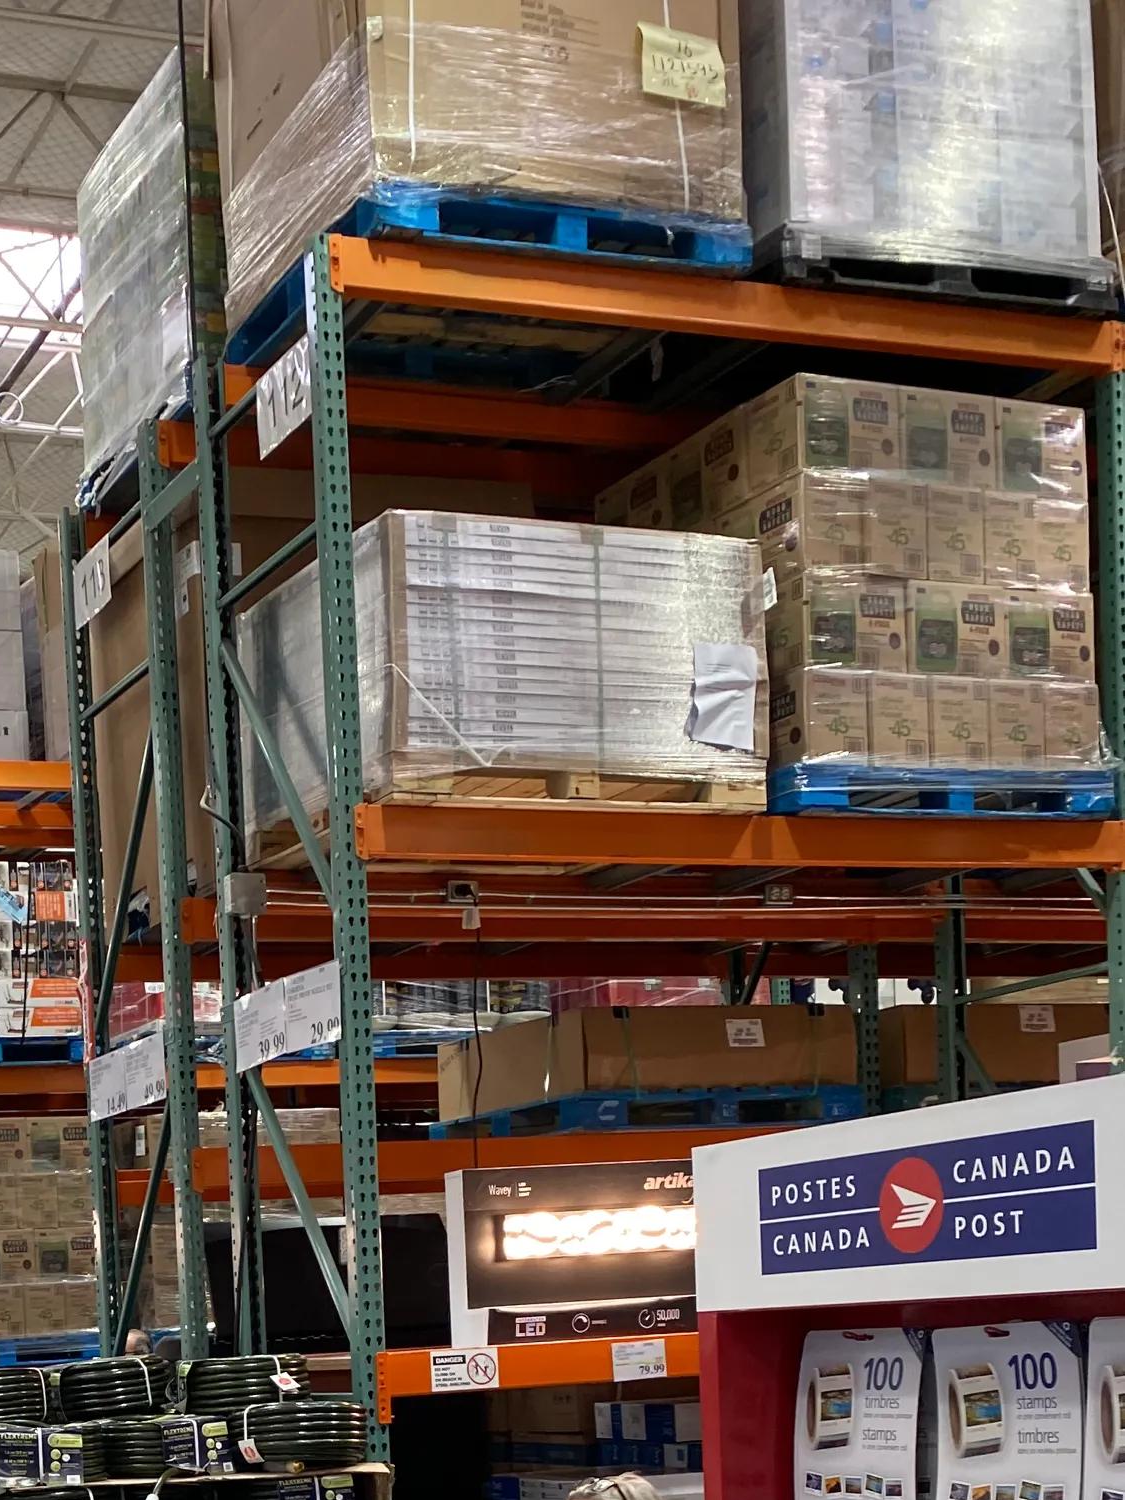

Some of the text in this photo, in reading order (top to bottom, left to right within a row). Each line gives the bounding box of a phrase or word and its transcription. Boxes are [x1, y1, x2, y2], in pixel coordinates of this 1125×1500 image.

[953, 1146, 1075, 1184] CANADA
[488, 1184, 512, 1196] Wavey
[771, 1175, 856, 1207] POSTES
[954, 1210, 1025, 1239] POST
[773, 1226, 870, 1256] CANADA
[515, 1308, 680, 1337] LED 50,000
[435, 1356, 464, 1364] DANGER
[638, 1363, 665, 1375] 79.99
[1008, 1352, 1058, 1390] 100
[864, 1357, 904, 1391] 100
[864, 1395, 900, 1409] timbres
[1016, 1395, 1057, 1412] stamps
[862, 1428, 897, 1443] stamps
[1018, 1428, 1060, 1444] timbres
